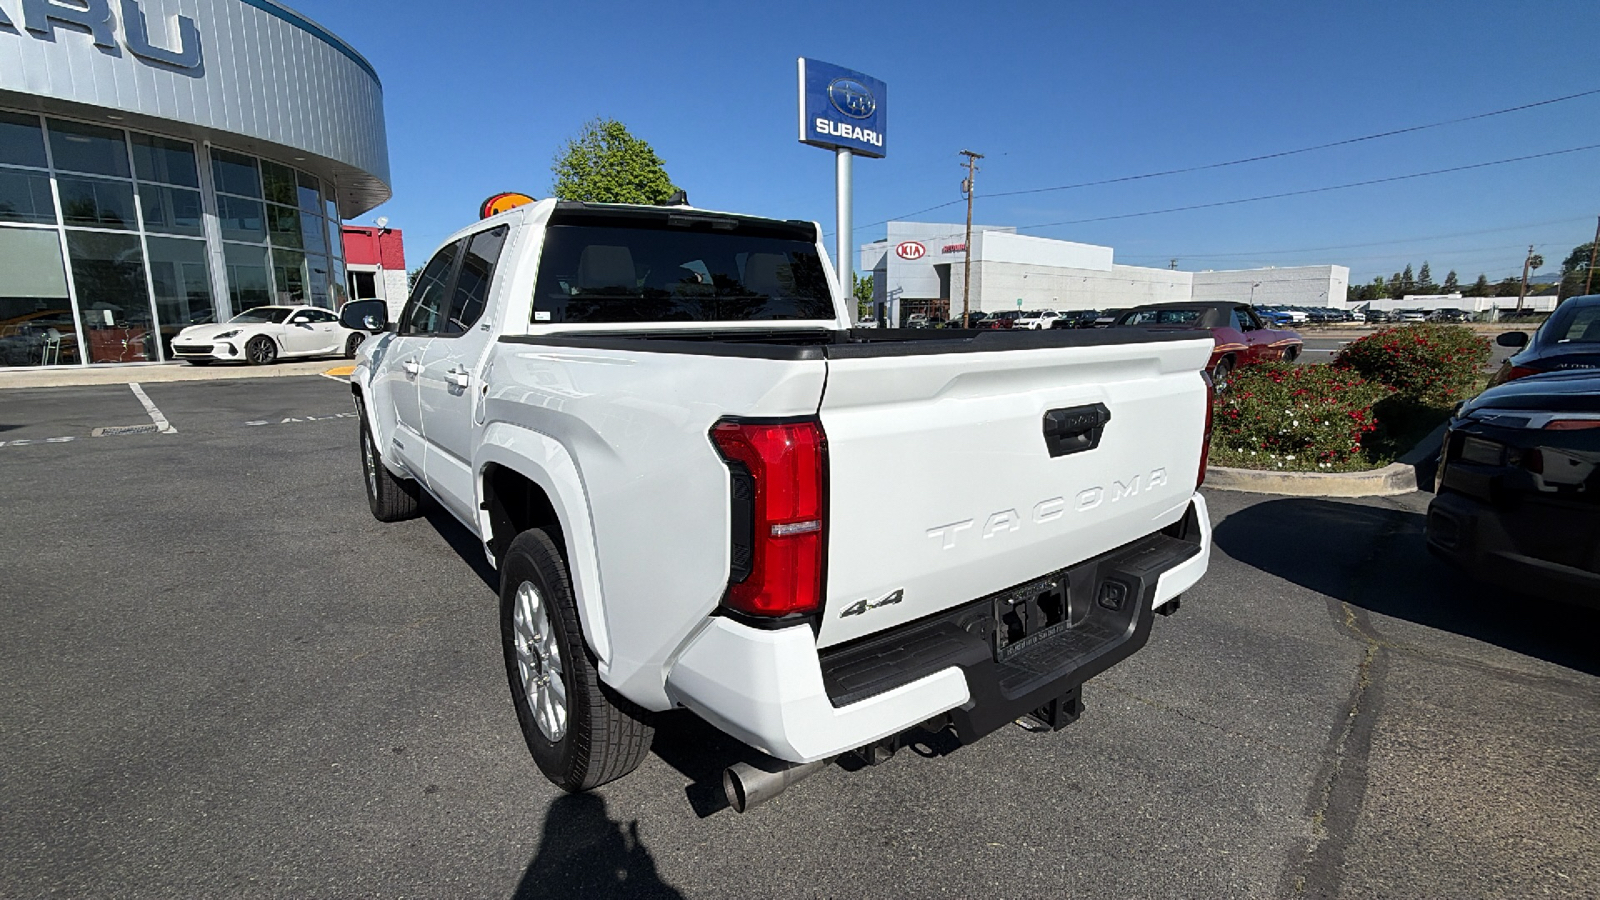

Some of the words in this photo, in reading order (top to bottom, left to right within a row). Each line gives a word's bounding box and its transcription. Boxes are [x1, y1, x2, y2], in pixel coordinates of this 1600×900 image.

[0, 0, 201, 69] RU
[815, 117, 883, 147] SUBARU
[901, 245, 922, 257] KIA
[925, 467, 1168, 550] TACOMA
